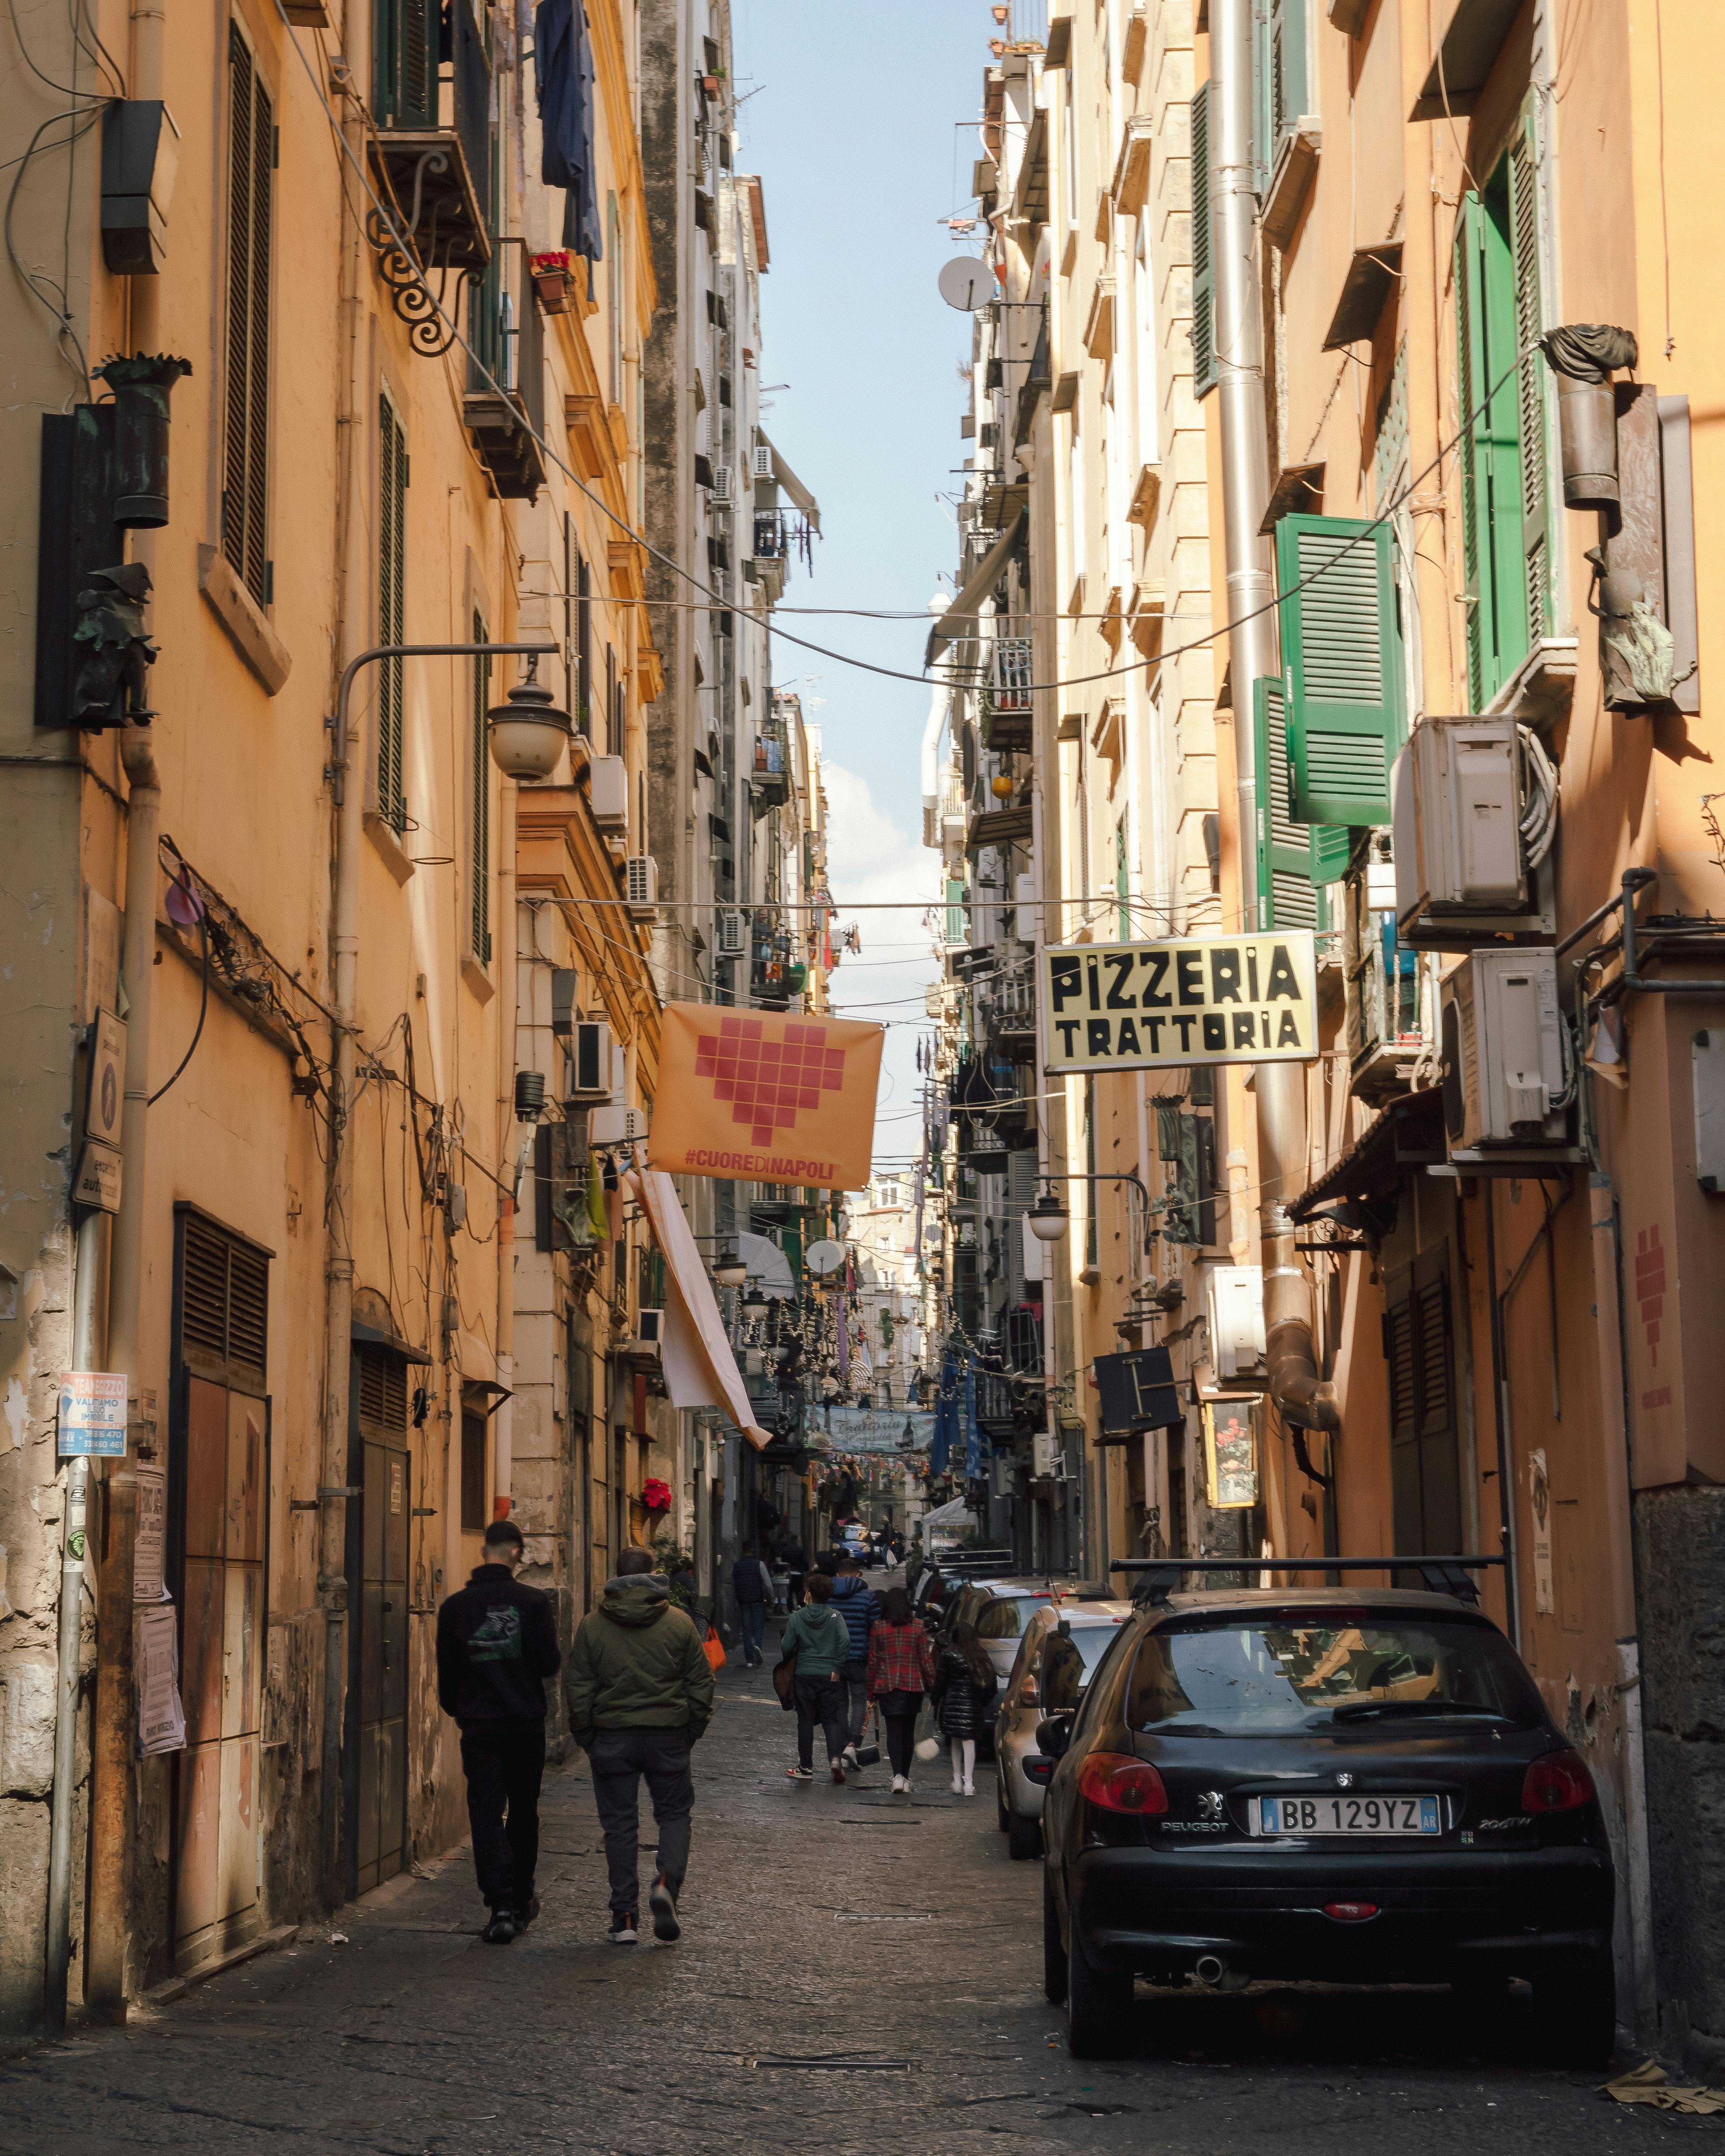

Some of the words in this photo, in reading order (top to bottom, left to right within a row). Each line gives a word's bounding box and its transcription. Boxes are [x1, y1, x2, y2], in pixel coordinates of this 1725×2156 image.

[685, 1149, 834, 1180] #CUOREDINAPOLI
[1161, 1822, 1229, 1832] PEUGEOT
[1282, 1800, 1317, 1829] BB
[1331, 1800, 1418, 1829] 129YZ
